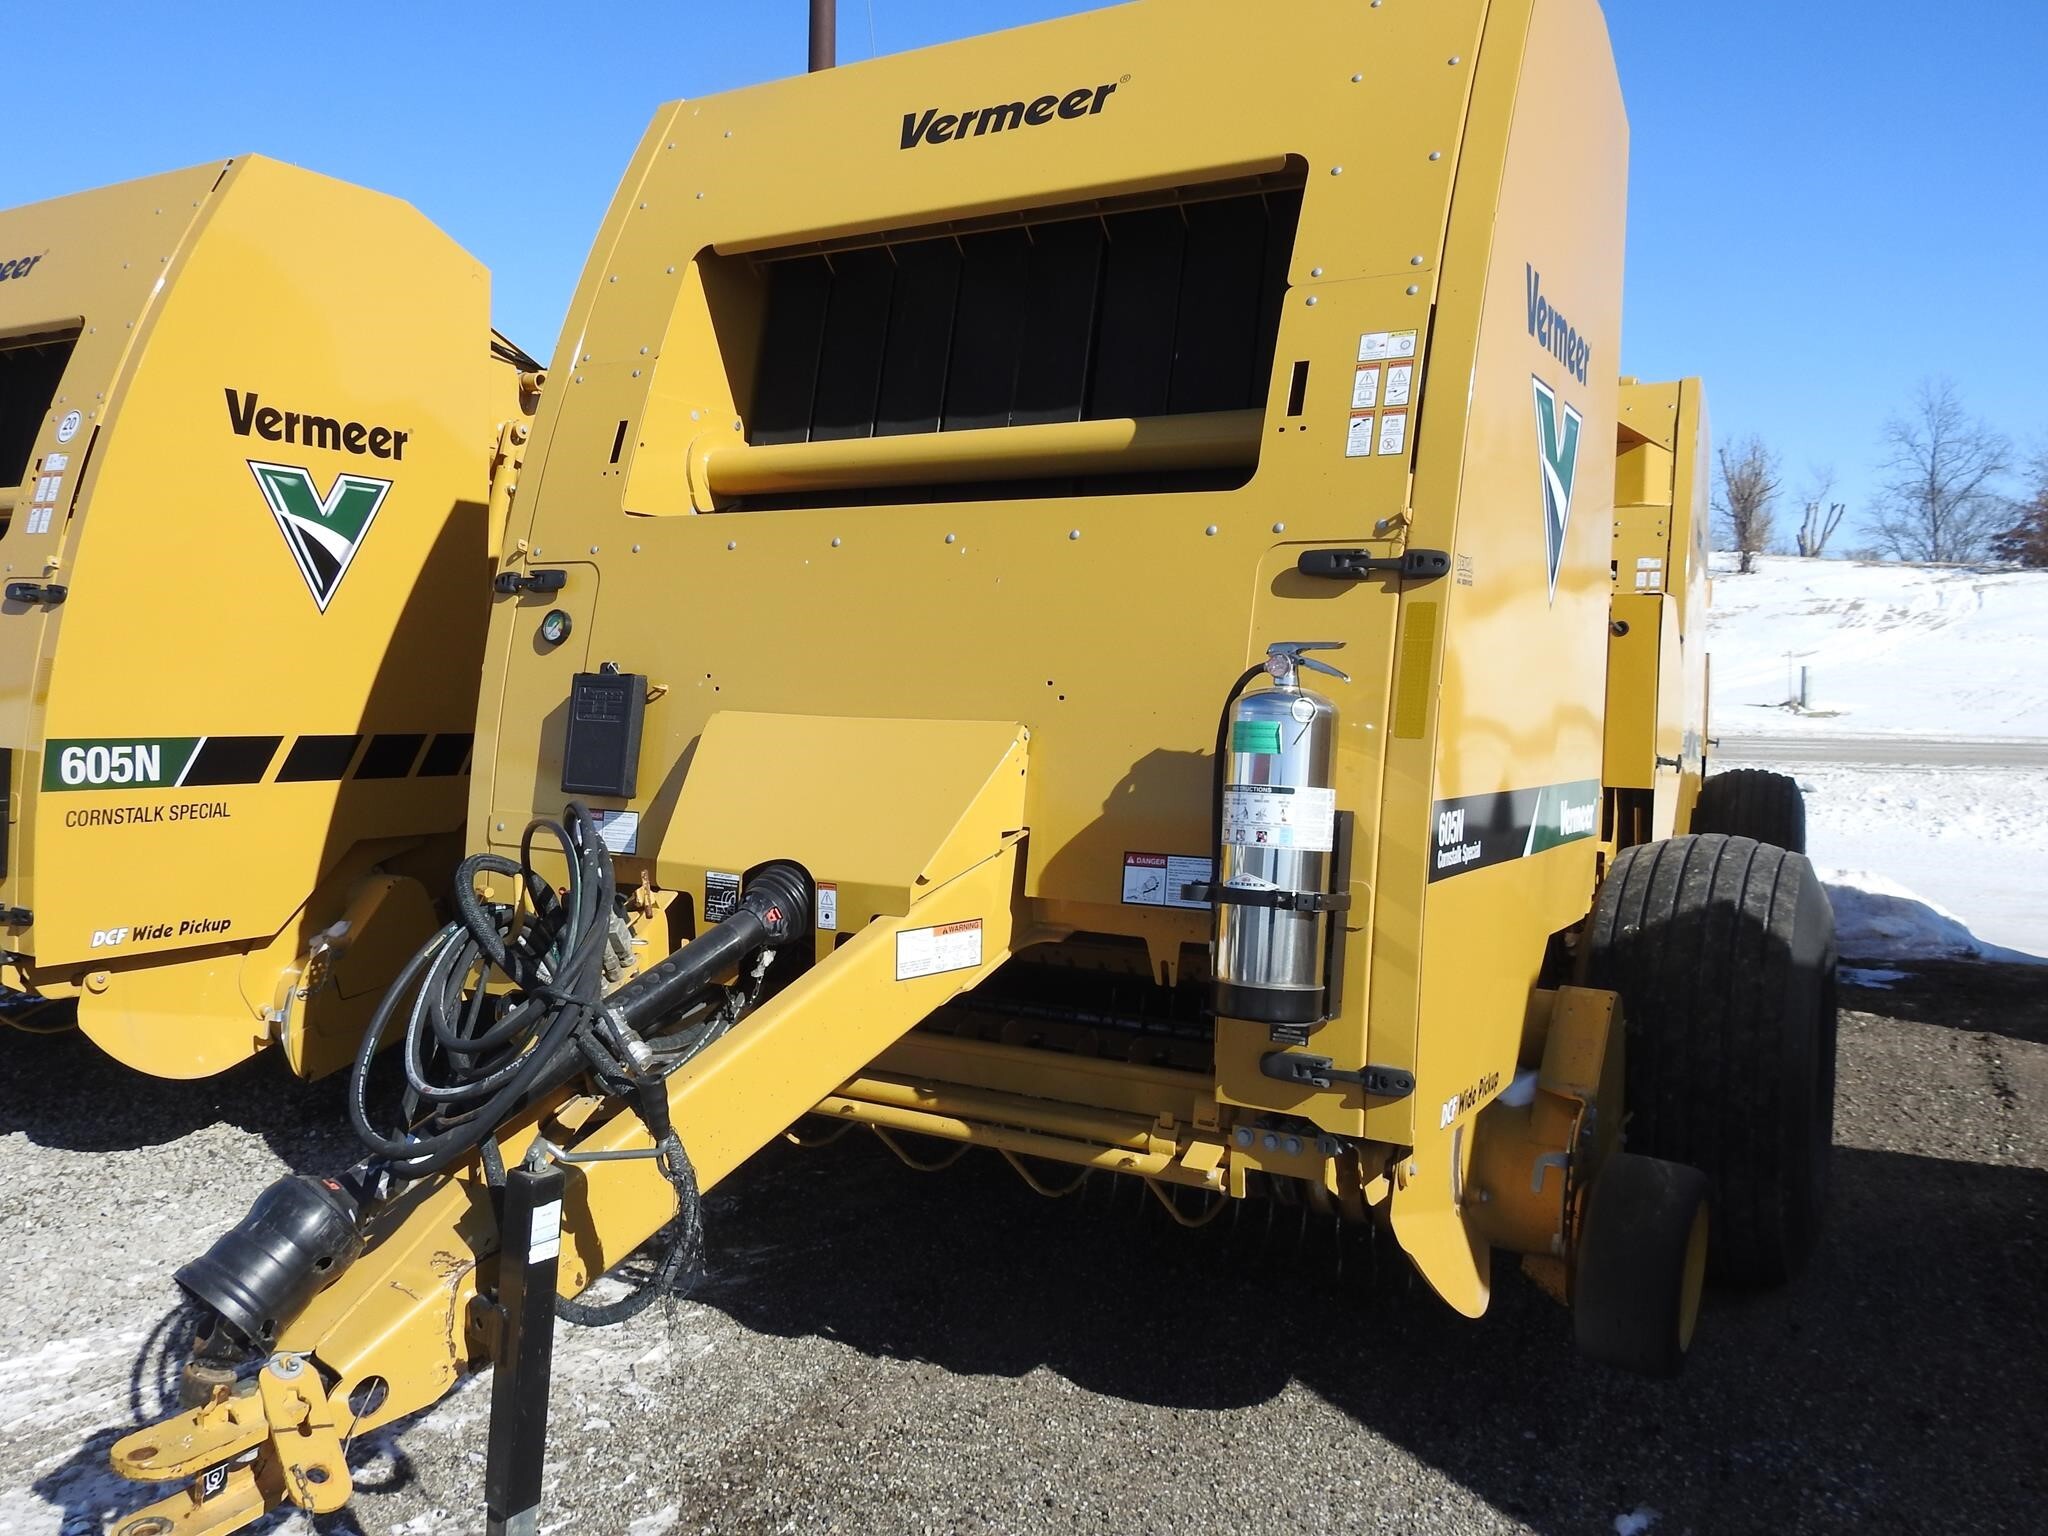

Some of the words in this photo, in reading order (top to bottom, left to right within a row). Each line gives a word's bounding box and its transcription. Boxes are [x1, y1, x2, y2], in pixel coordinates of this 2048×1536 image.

[900, 83, 1118, 150] Vermeer
[0, 255, 43, 282] eer
[1526, 261, 1590, 387] Vermeer
[224, 387, 408, 461] Vermeer
[60, 744, 161, 785] 605N
[65, 805, 165, 828] CORNSTALK
[169, 802, 231, 821] SPECIAL
[1438, 808, 1465, 847] 605N
[1136, 857, 1166, 865] DANGER
[90, 928, 128, 948] DCF
[132, 924, 173, 942] Wide
[179, 918, 232, 936] Pickup
[949, 921, 979, 933] WARNING
[1458, 1085, 1477, 1116] Wide
[1477, 1071, 1499, 1101] Pickup
